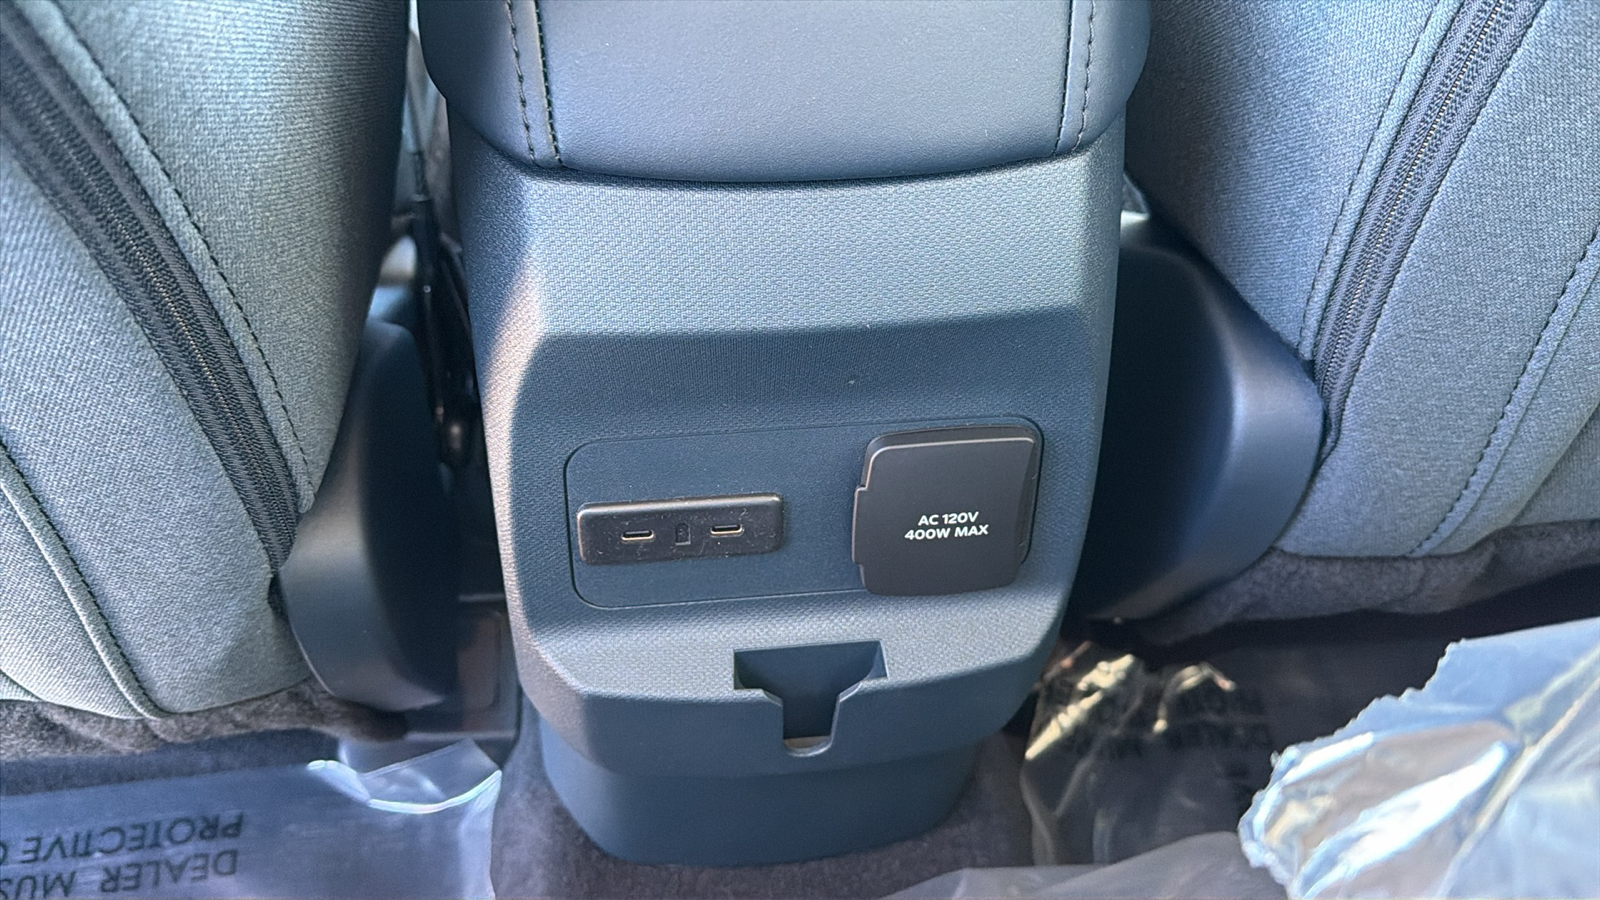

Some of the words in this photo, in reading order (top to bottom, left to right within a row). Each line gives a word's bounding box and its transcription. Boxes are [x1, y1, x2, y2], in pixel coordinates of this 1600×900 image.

[904, 527, 951, 540] 400W
[954, 524, 989, 538] MAX
[918, 514, 939, 526] AC
[941, 511, 979, 525] 120V
[19, 812, 244, 864] PROTECTIVE
[99, 849, 238, 893] DEALER
